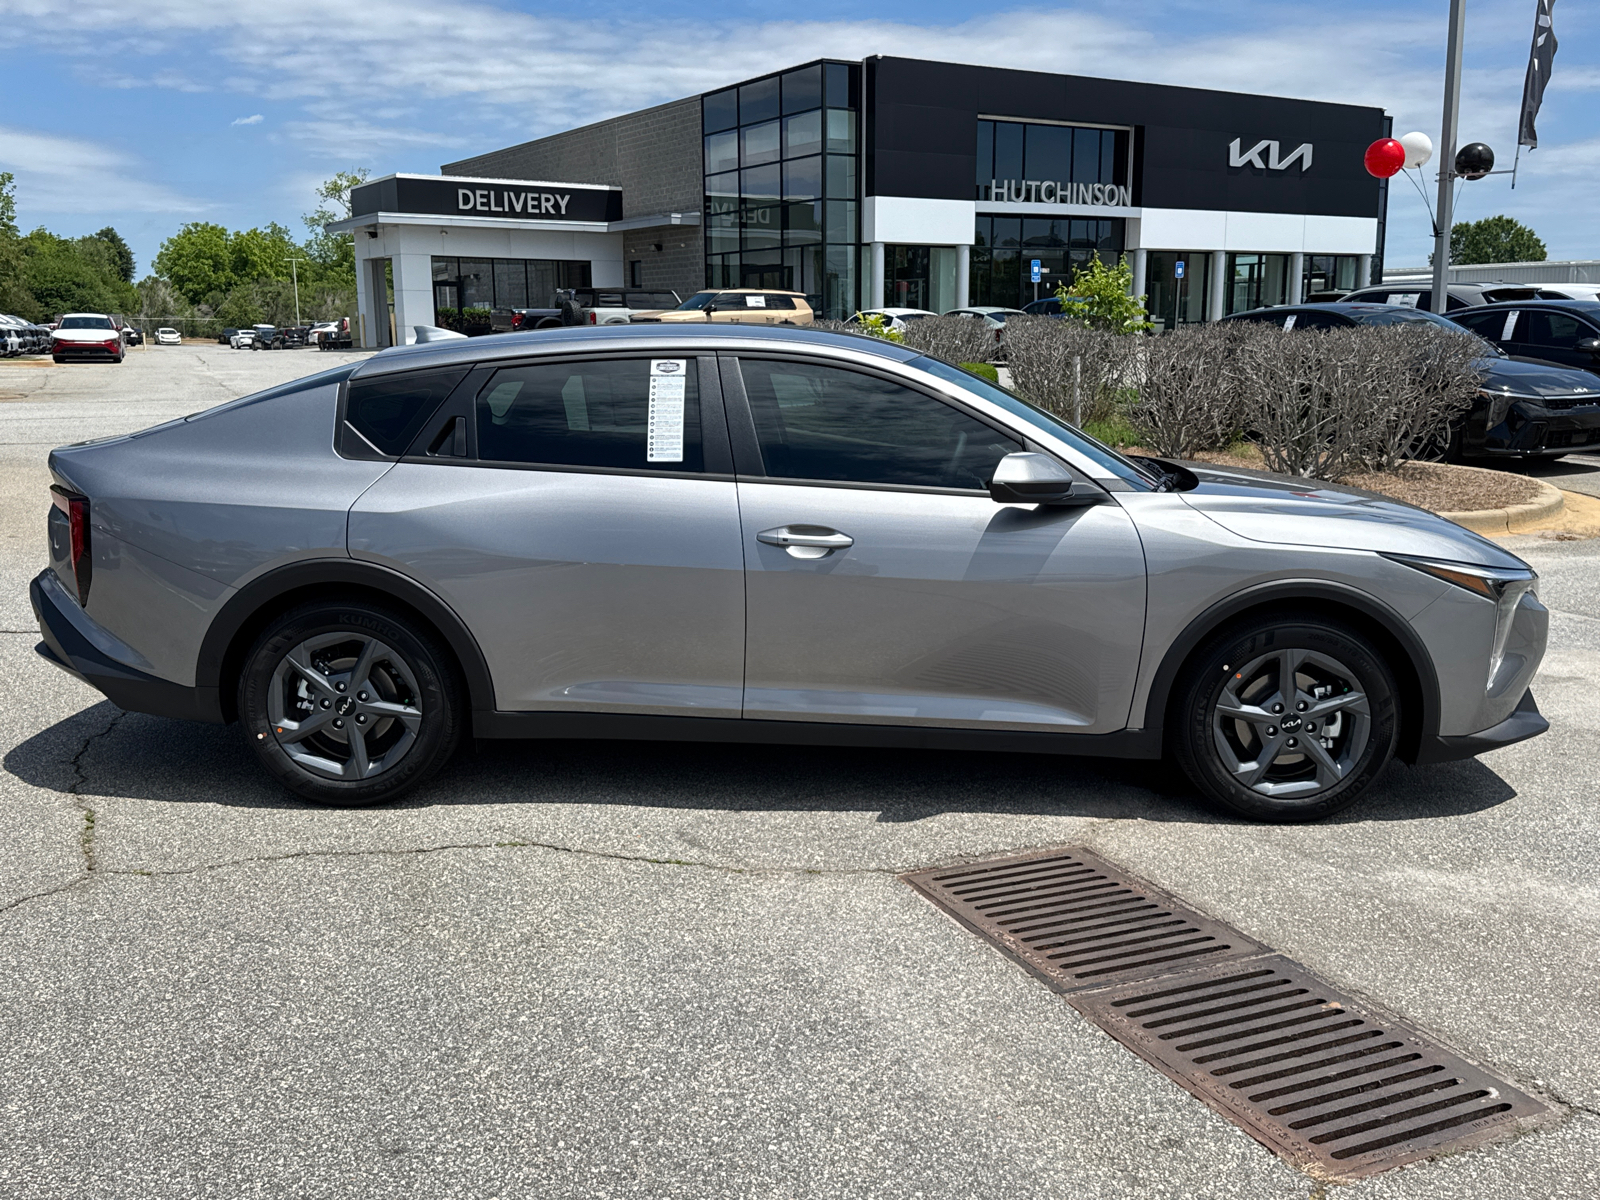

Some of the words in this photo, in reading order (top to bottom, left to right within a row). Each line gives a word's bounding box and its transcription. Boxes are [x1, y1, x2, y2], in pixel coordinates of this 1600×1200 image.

[1229, 137, 1313, 171] KIA
[457, 188, 570, 215] DELIVERY
[990, 179, 1132, 207] HUTCHINSON
[338, 614, 400, 640] KUMHO
[1194, 695, 1209, 755] SOLUS
[1281, 718, 1302, 729] KIA
[1316, 773, 1371, 811] KUMHO
